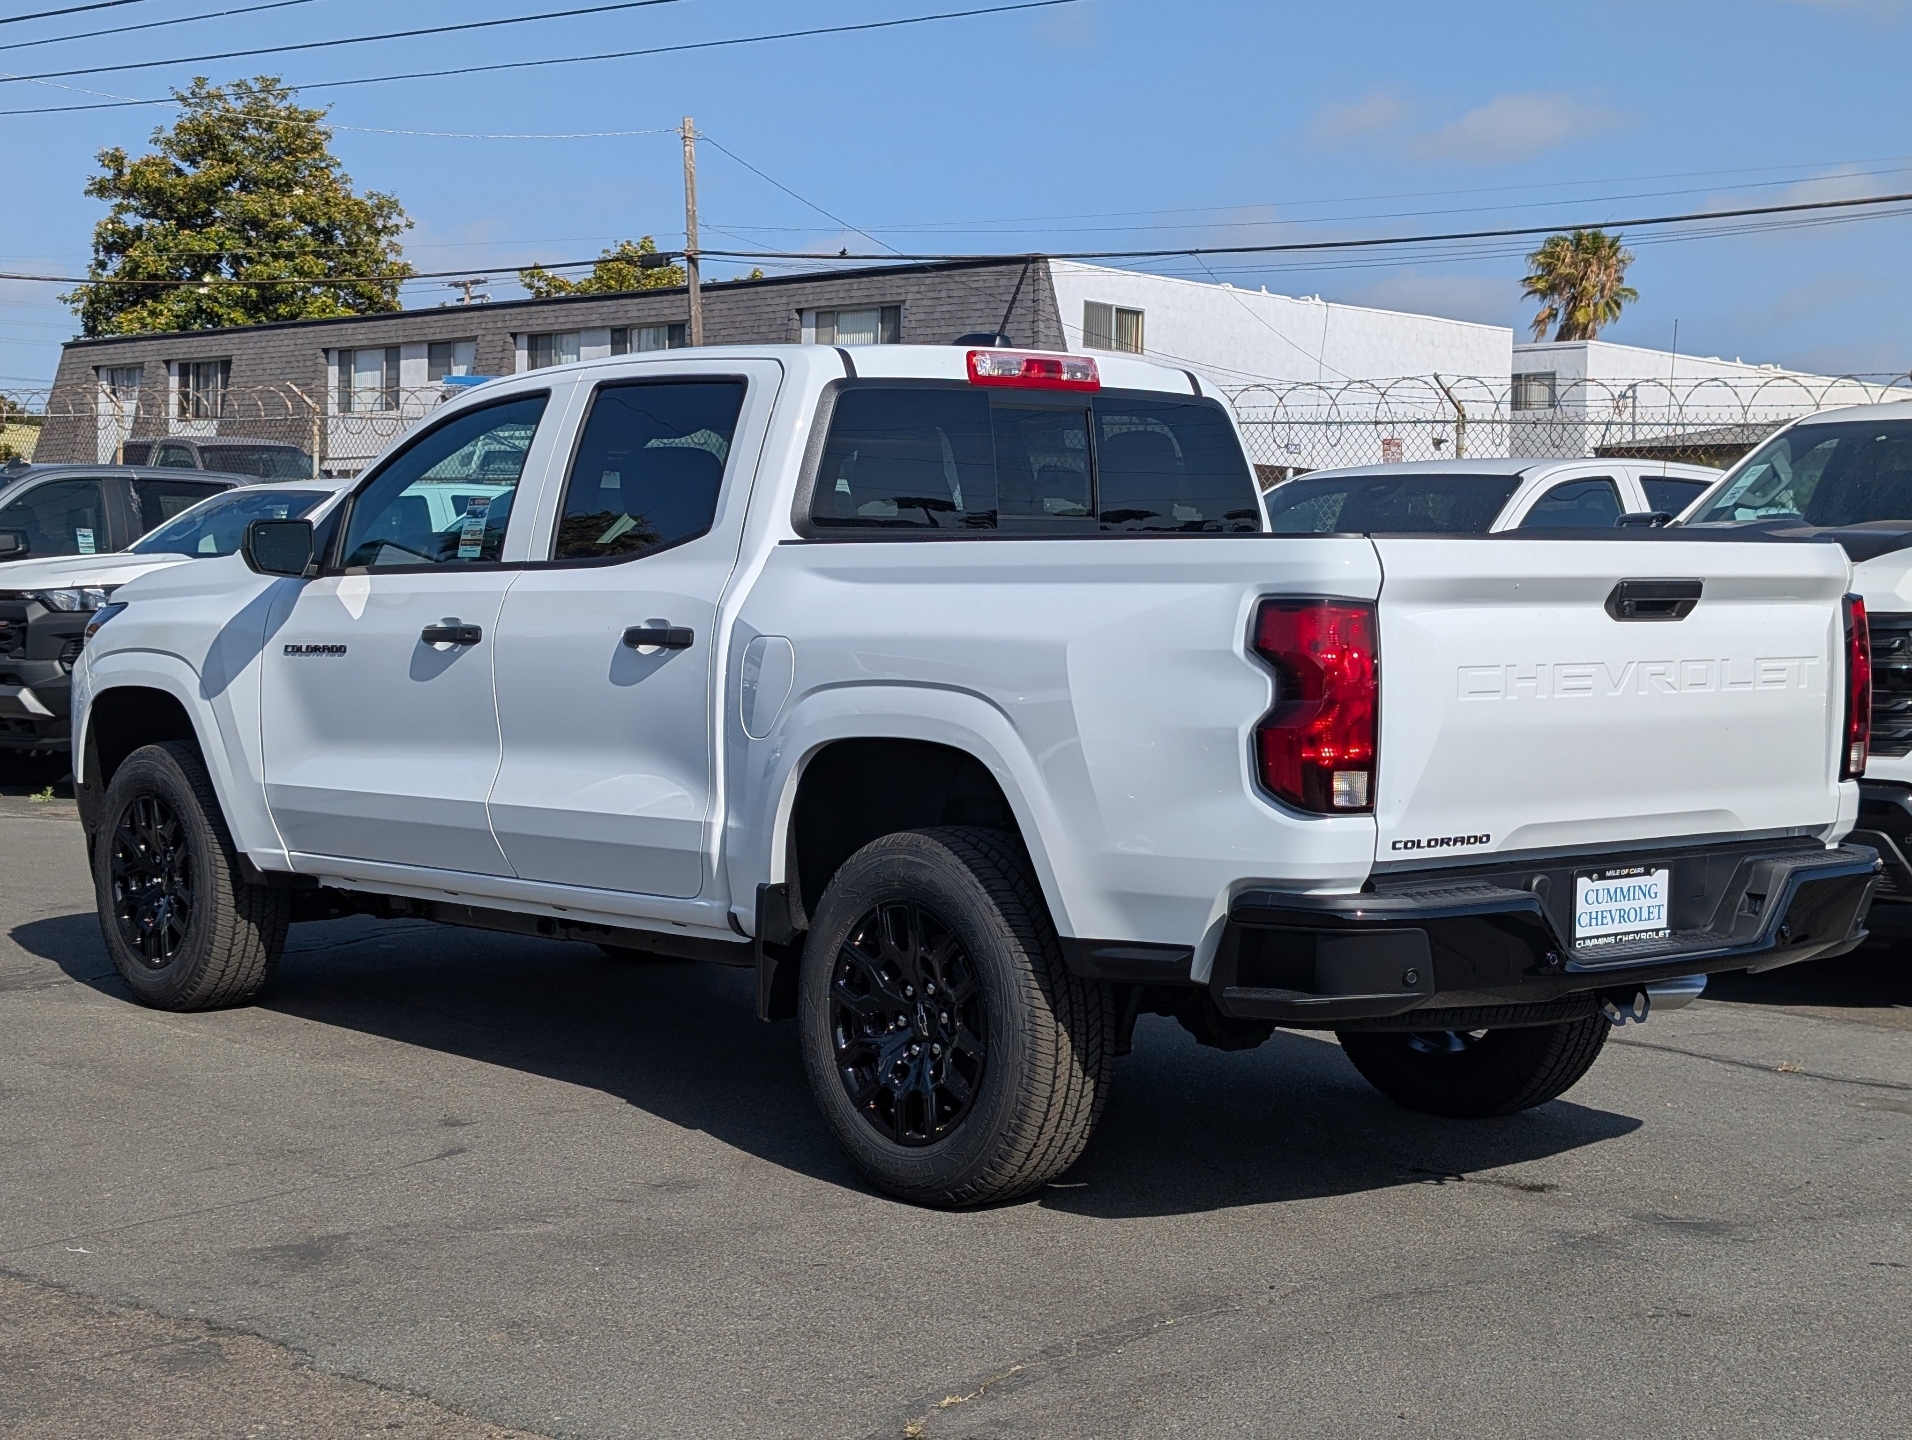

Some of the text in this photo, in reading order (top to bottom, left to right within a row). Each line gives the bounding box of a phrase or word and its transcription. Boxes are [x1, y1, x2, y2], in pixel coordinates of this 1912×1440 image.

[284, 644, 348, 655] COLORADO
[1456, 655, 1820, 701] CHEVROLET
[1391, 833, 1491, 851] COLORADO
[1584, 883, 1659, 906] CUMMING
[1577, 903, 1665, 928] CHEVROLET
[865, 867, 1002, 1010] GOODYEAR
[1575, 929, 1671, 949] CUMMING CHEVROLET
